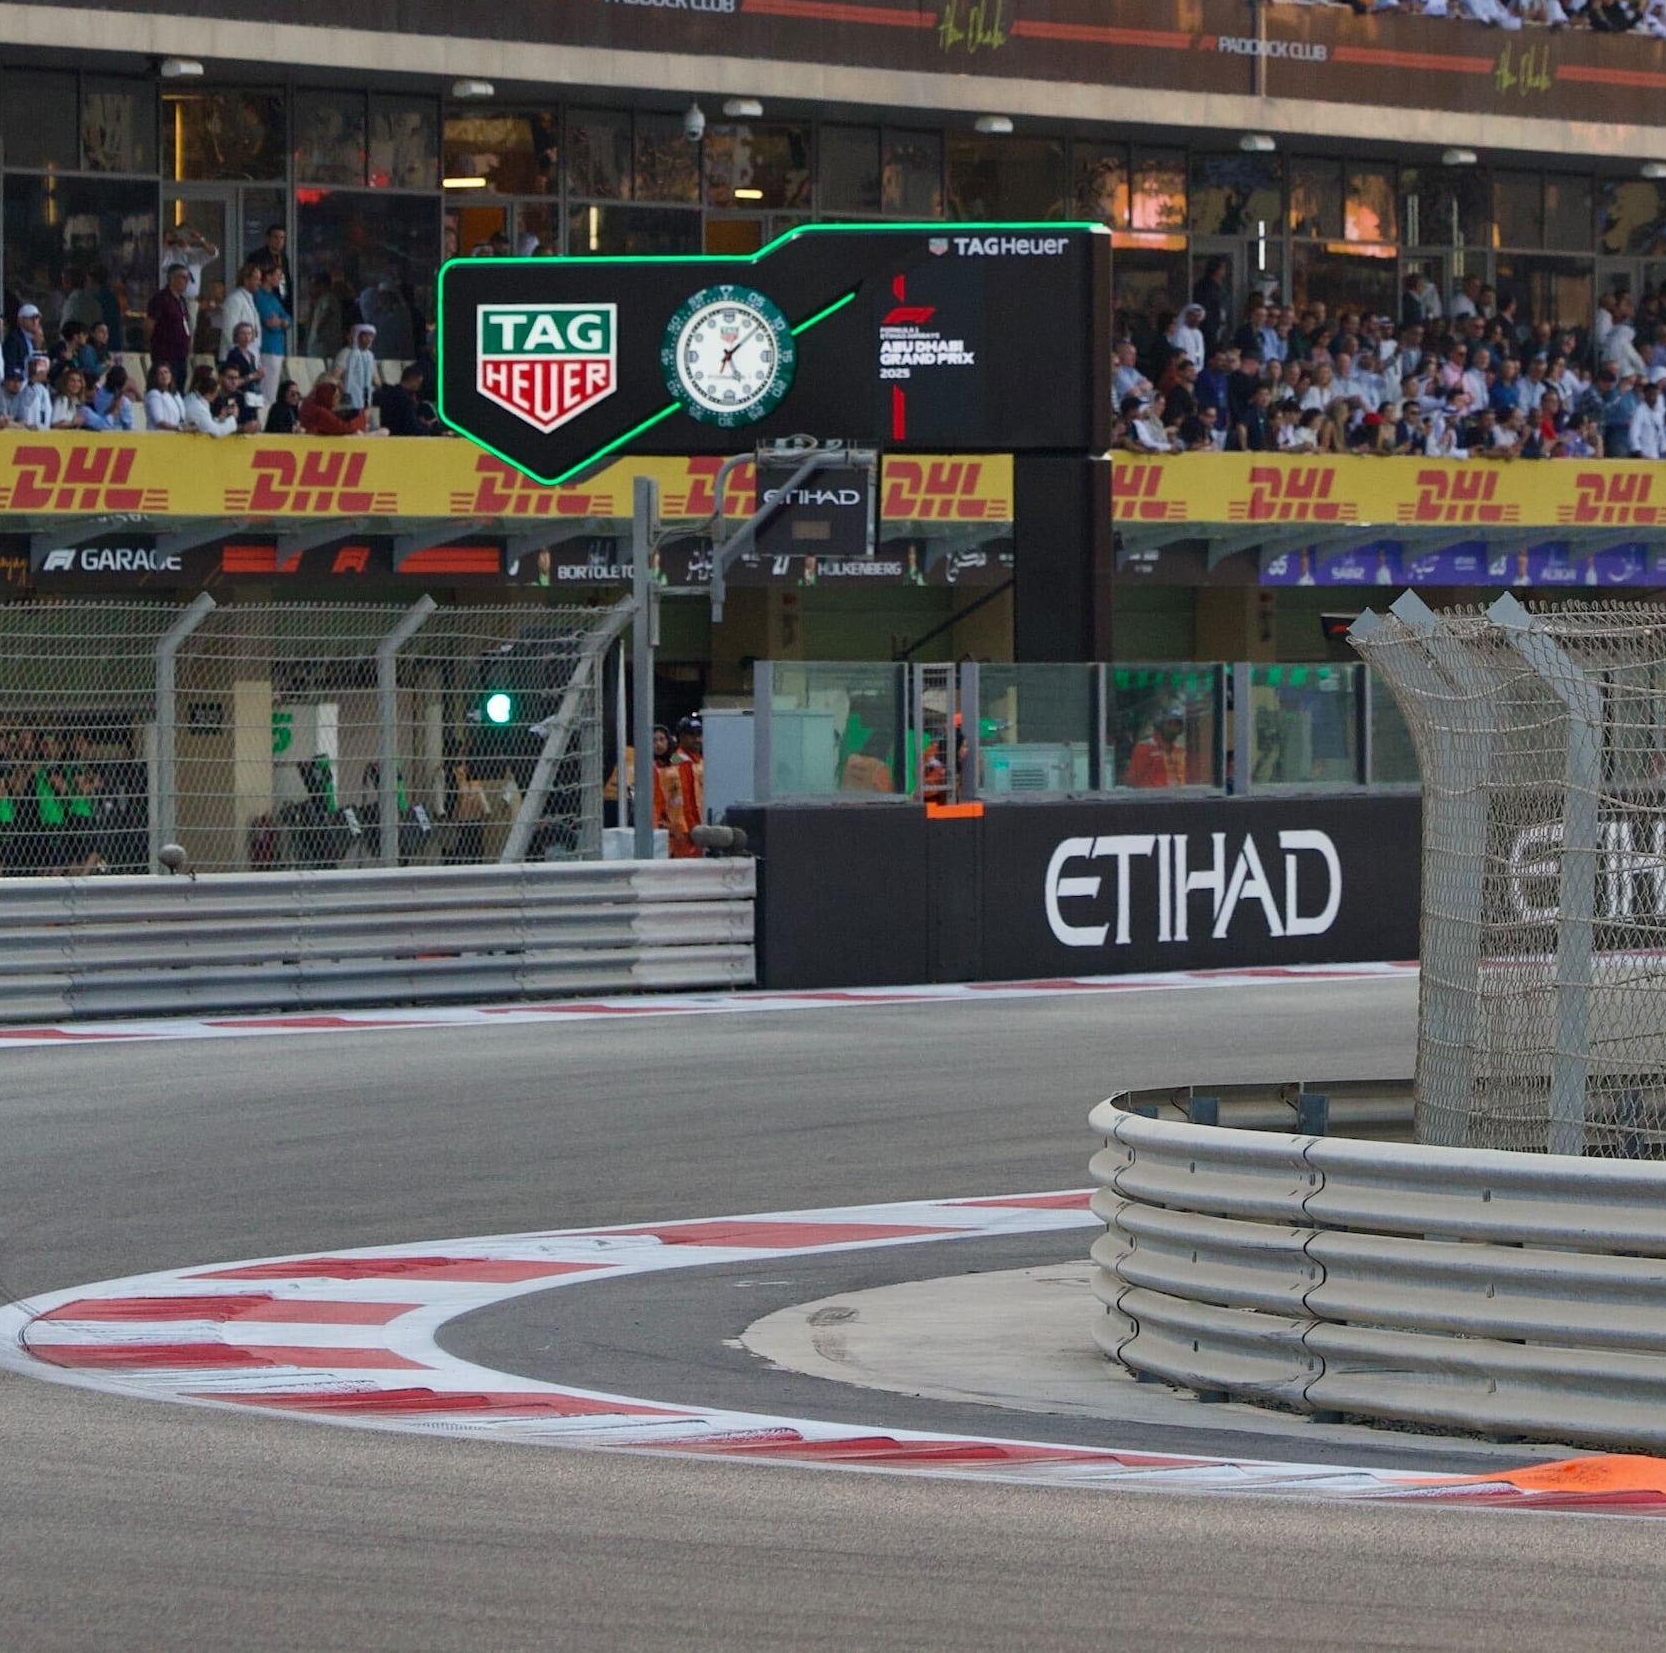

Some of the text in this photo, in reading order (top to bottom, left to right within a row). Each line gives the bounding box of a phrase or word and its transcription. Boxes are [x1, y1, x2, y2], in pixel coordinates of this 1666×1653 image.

[1218, 35, 1327, 62] PADDOCK CLUB
[489, 313, 603, 351] TAG
[879, 339, 964, 353] ABU DHABI
[879, 352, 975, 365] GRAND PRIX
[485, 363, 606, 421] HEUER
[879, 368, 910, 379] 2025
[10, 445, 143, 511] DHL
[244, 449, 375, 513] DHL
[883, 460, 987, 518] DHL
[1246, 466, 1340, 521] DHL
[1415, 469, 1503, 522] DHL
[1575, 473, 1658, 524] DHL
[1044, 829, 1342, 947] ETIHAD
